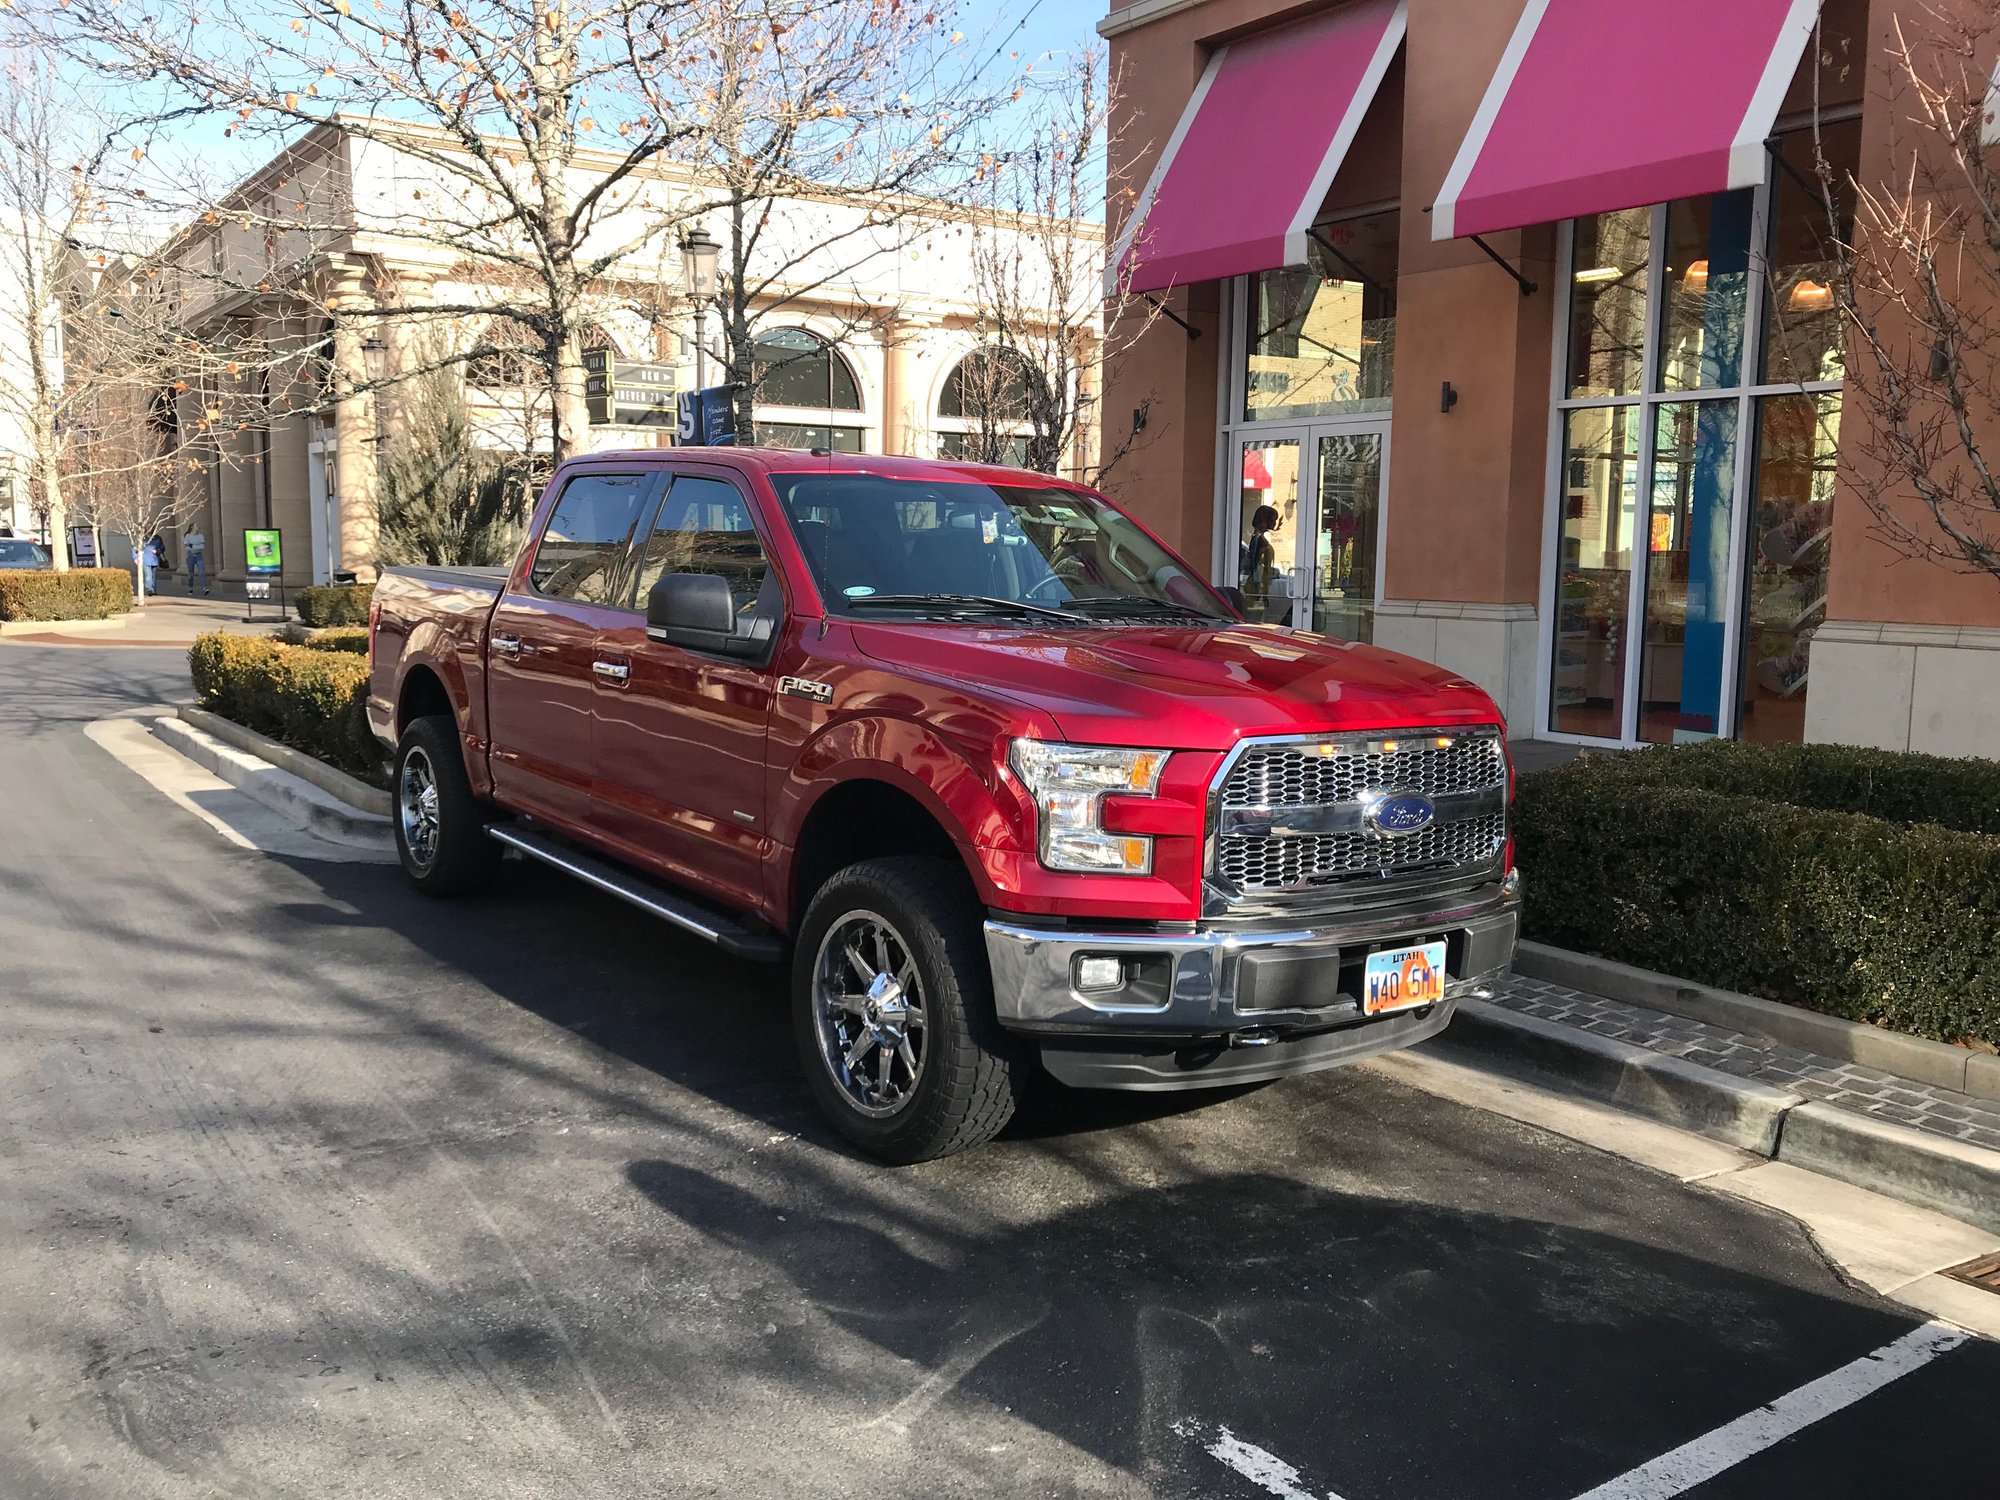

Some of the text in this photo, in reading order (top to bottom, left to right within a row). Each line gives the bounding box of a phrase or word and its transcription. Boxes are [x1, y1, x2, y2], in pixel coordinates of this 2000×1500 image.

[614, 390, 660, 403] OREVER 21
[1389, 805, 1424, 827] Ford
[1392, 951, 1420, 964] UTAH
[1370, 971, 1400, 1005] W40
